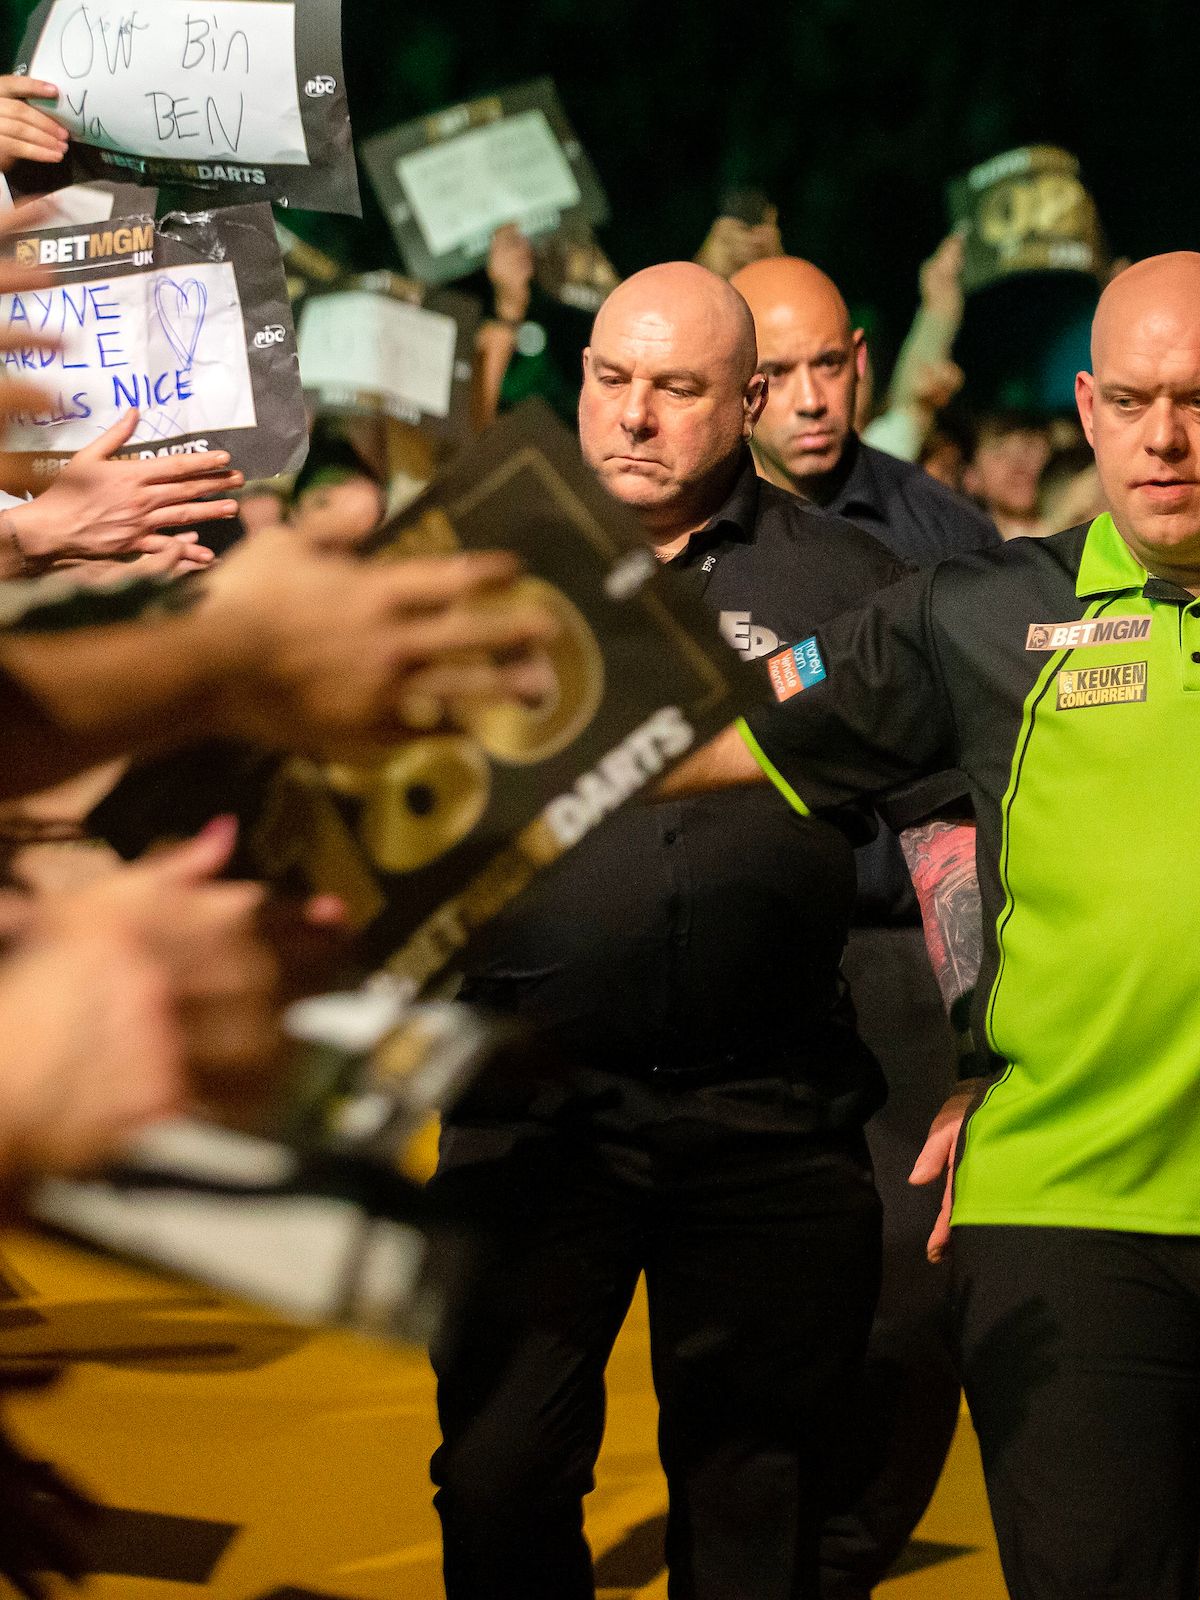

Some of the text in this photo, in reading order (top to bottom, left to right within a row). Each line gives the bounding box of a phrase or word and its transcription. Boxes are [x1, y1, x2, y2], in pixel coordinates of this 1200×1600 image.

[182, 14, 249, 73] Bin
[306, 76, 337, 98] PDC
[145, 91, 244, 152] BEN
[39, 225, 154, 264] BETMGM
[133, 250, 154, 266] UK
[0, 285, 121, 333] AYNE
[254, 324, 286, 348] PDC
[113, 368, 194, 409] NICE
[702, 556, 716, 573] EPS
[1051, 619, 1150, 647] BETMGM
[805, 640, 822, 675] money
[1077, 664, 1144, 690] KEUKEN
[1060, 685, 1144, 708] CONCURRENT
